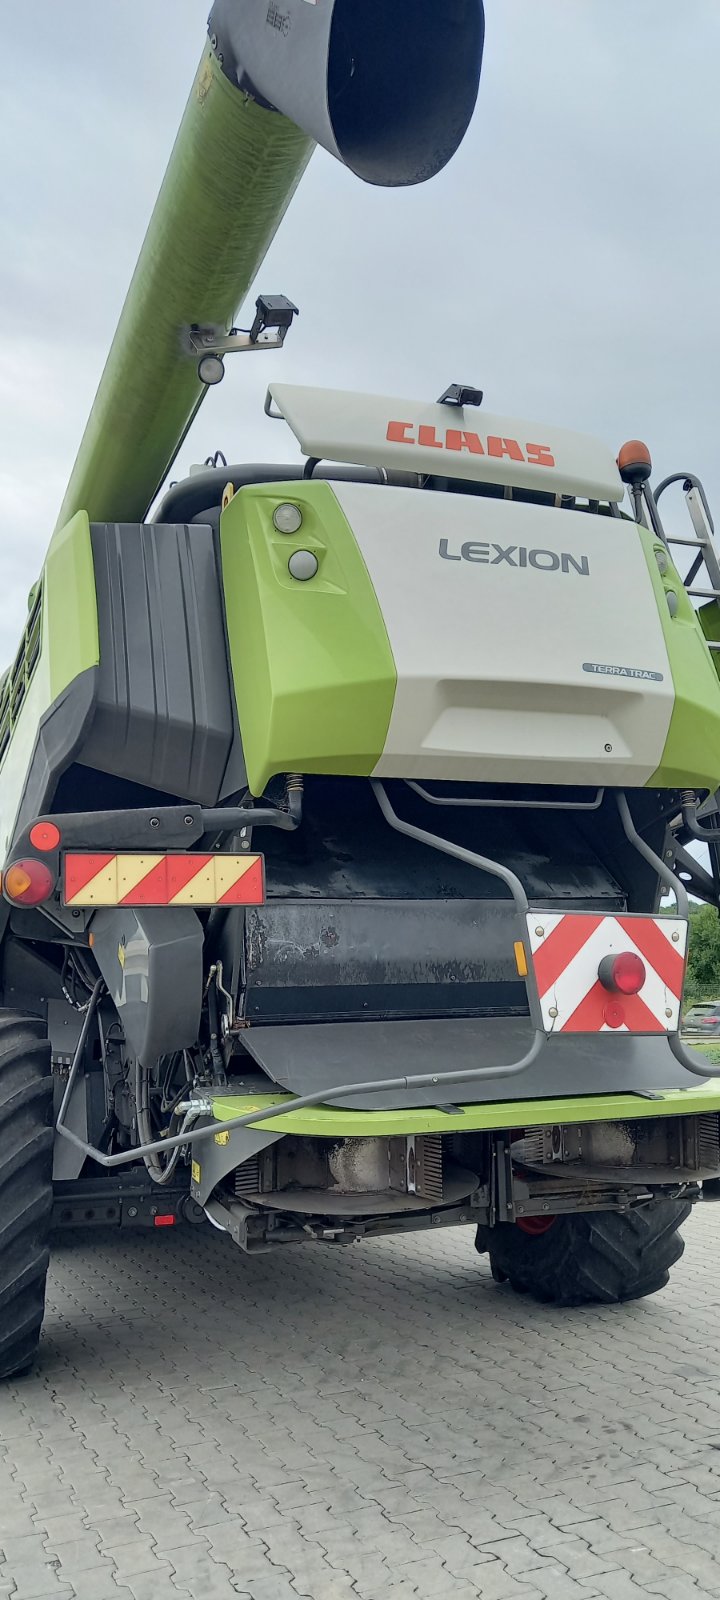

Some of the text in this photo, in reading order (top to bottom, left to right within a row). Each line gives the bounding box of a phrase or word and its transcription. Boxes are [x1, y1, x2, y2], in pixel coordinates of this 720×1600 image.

[386, 421, 555, 467] CLAAS
[438, 538, 590, 576] LEXION
[592, 664, 656, 680] TERRA TRAC
